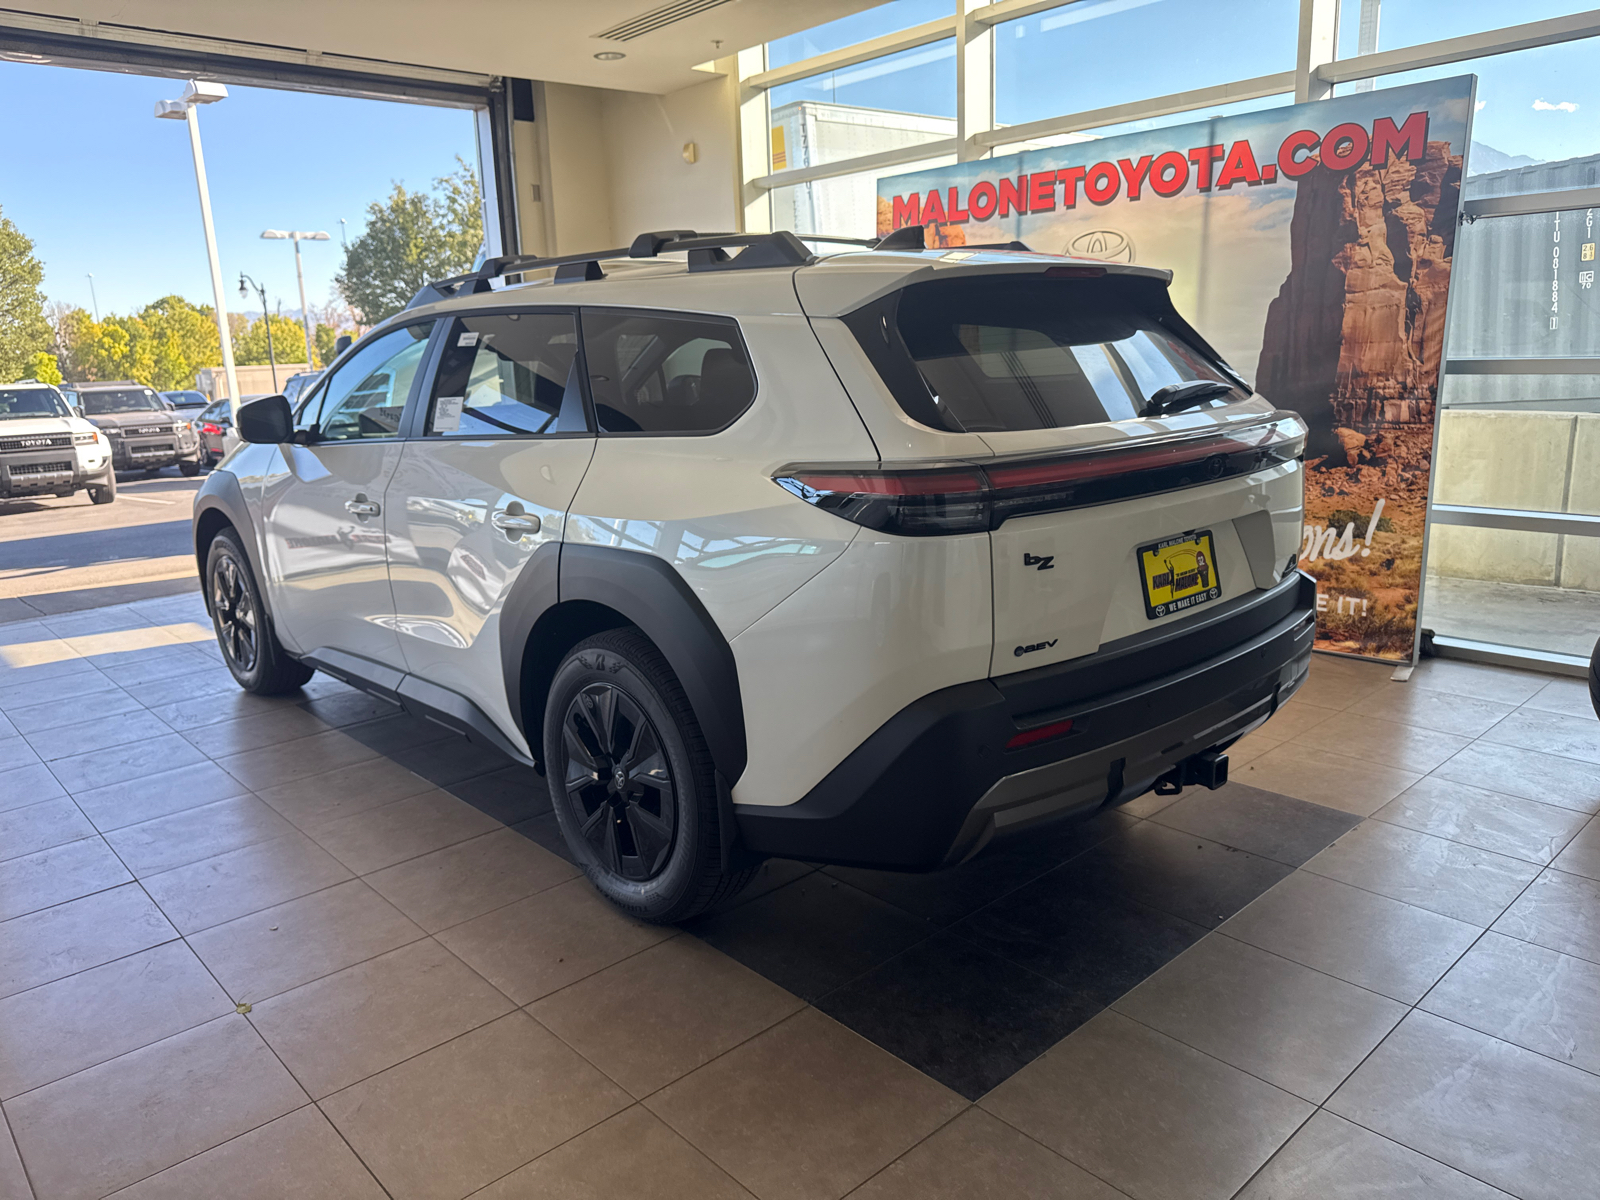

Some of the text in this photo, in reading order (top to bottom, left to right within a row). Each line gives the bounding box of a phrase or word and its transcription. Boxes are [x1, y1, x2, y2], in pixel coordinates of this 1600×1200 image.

[891, 110, 1431, 231] MALONETOYOTA.COM
[1551, 246, 1560, 314] 081884
[20, 438, 52, 447] TOYOTA
[1197, 555, 1206, 566] 32
[1152, 571, 1171, 590] KARL
[1168, 592, 1207, 612] WE MAKE IT EASY
[1337, 595, 1368, 617] IT!
